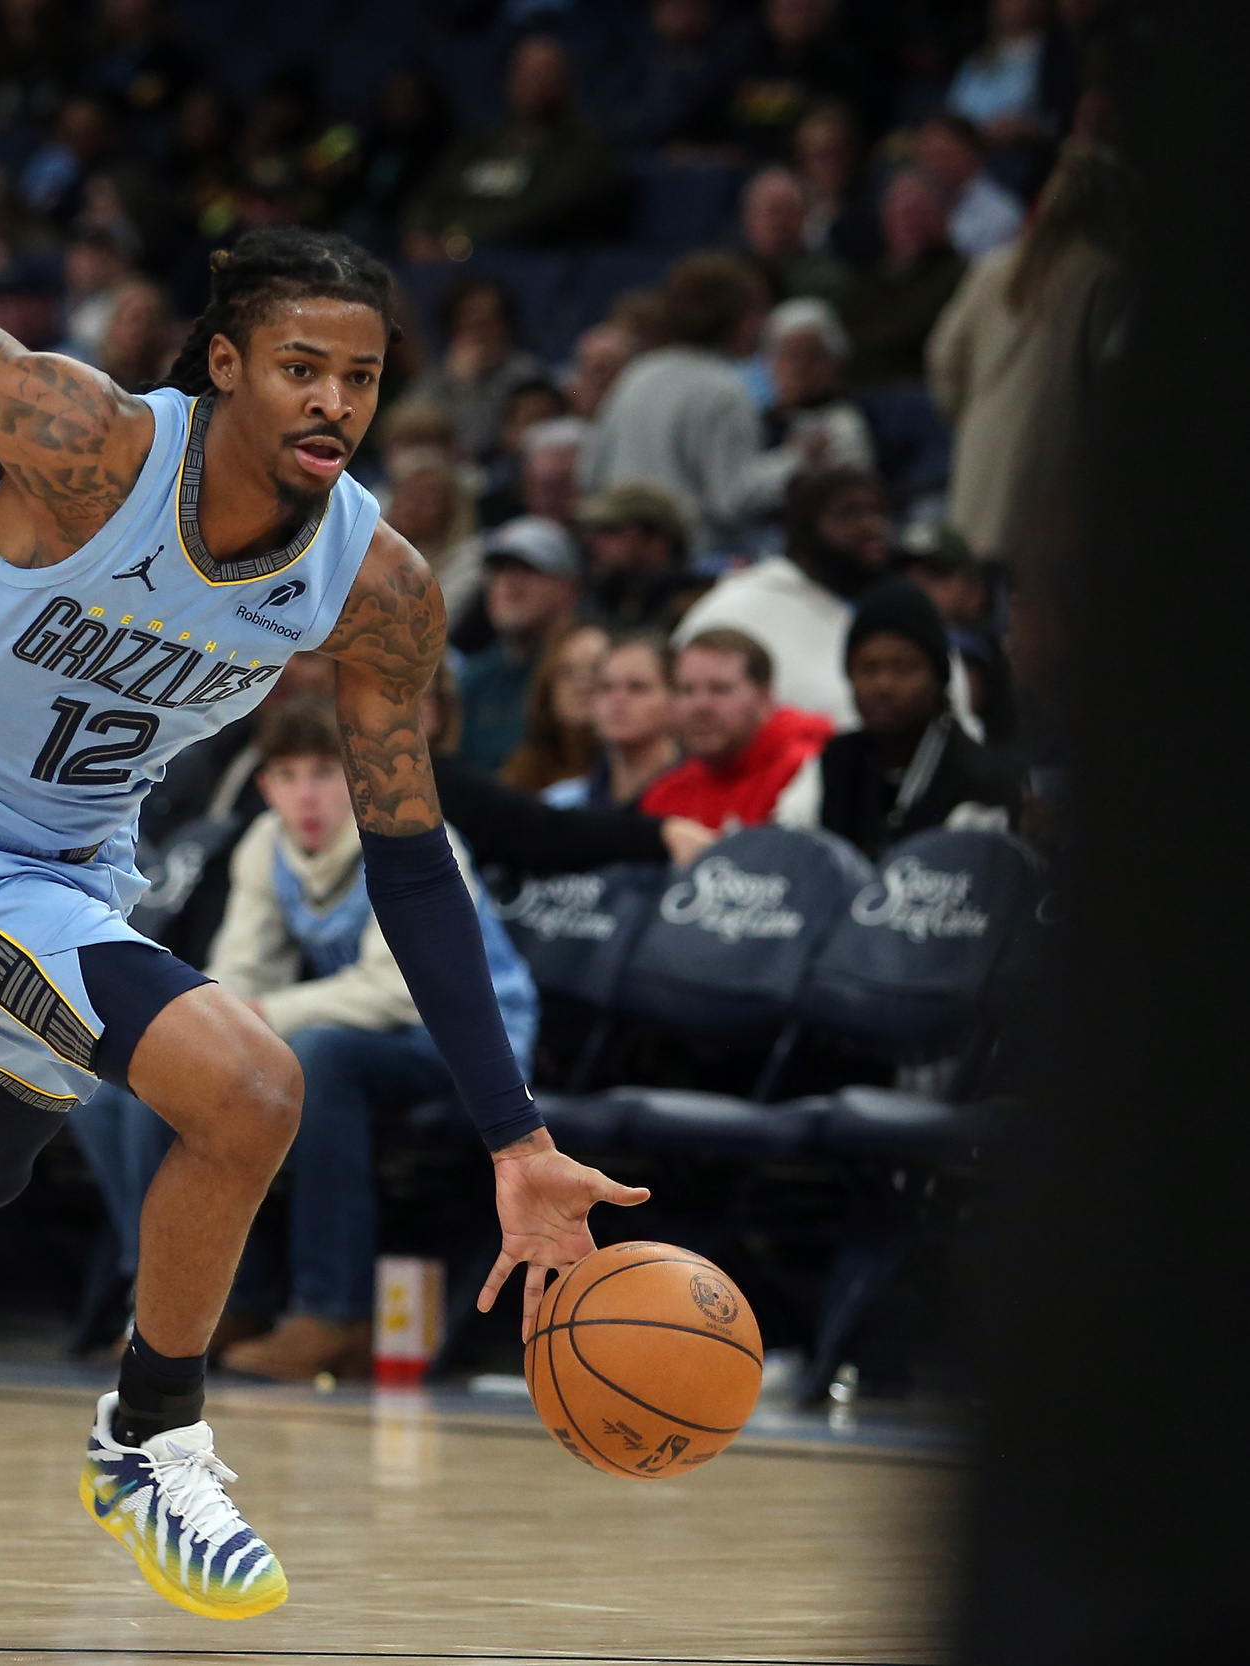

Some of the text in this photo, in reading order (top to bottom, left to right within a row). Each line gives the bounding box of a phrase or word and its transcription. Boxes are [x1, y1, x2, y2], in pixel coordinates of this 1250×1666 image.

[12, 596, 283, 708] GRIZZLIES
[88, 605, 261, 668] MEMPHIS
[235, 605, 302, 641] Robinhood
[30, 695, 160, 785] 12
